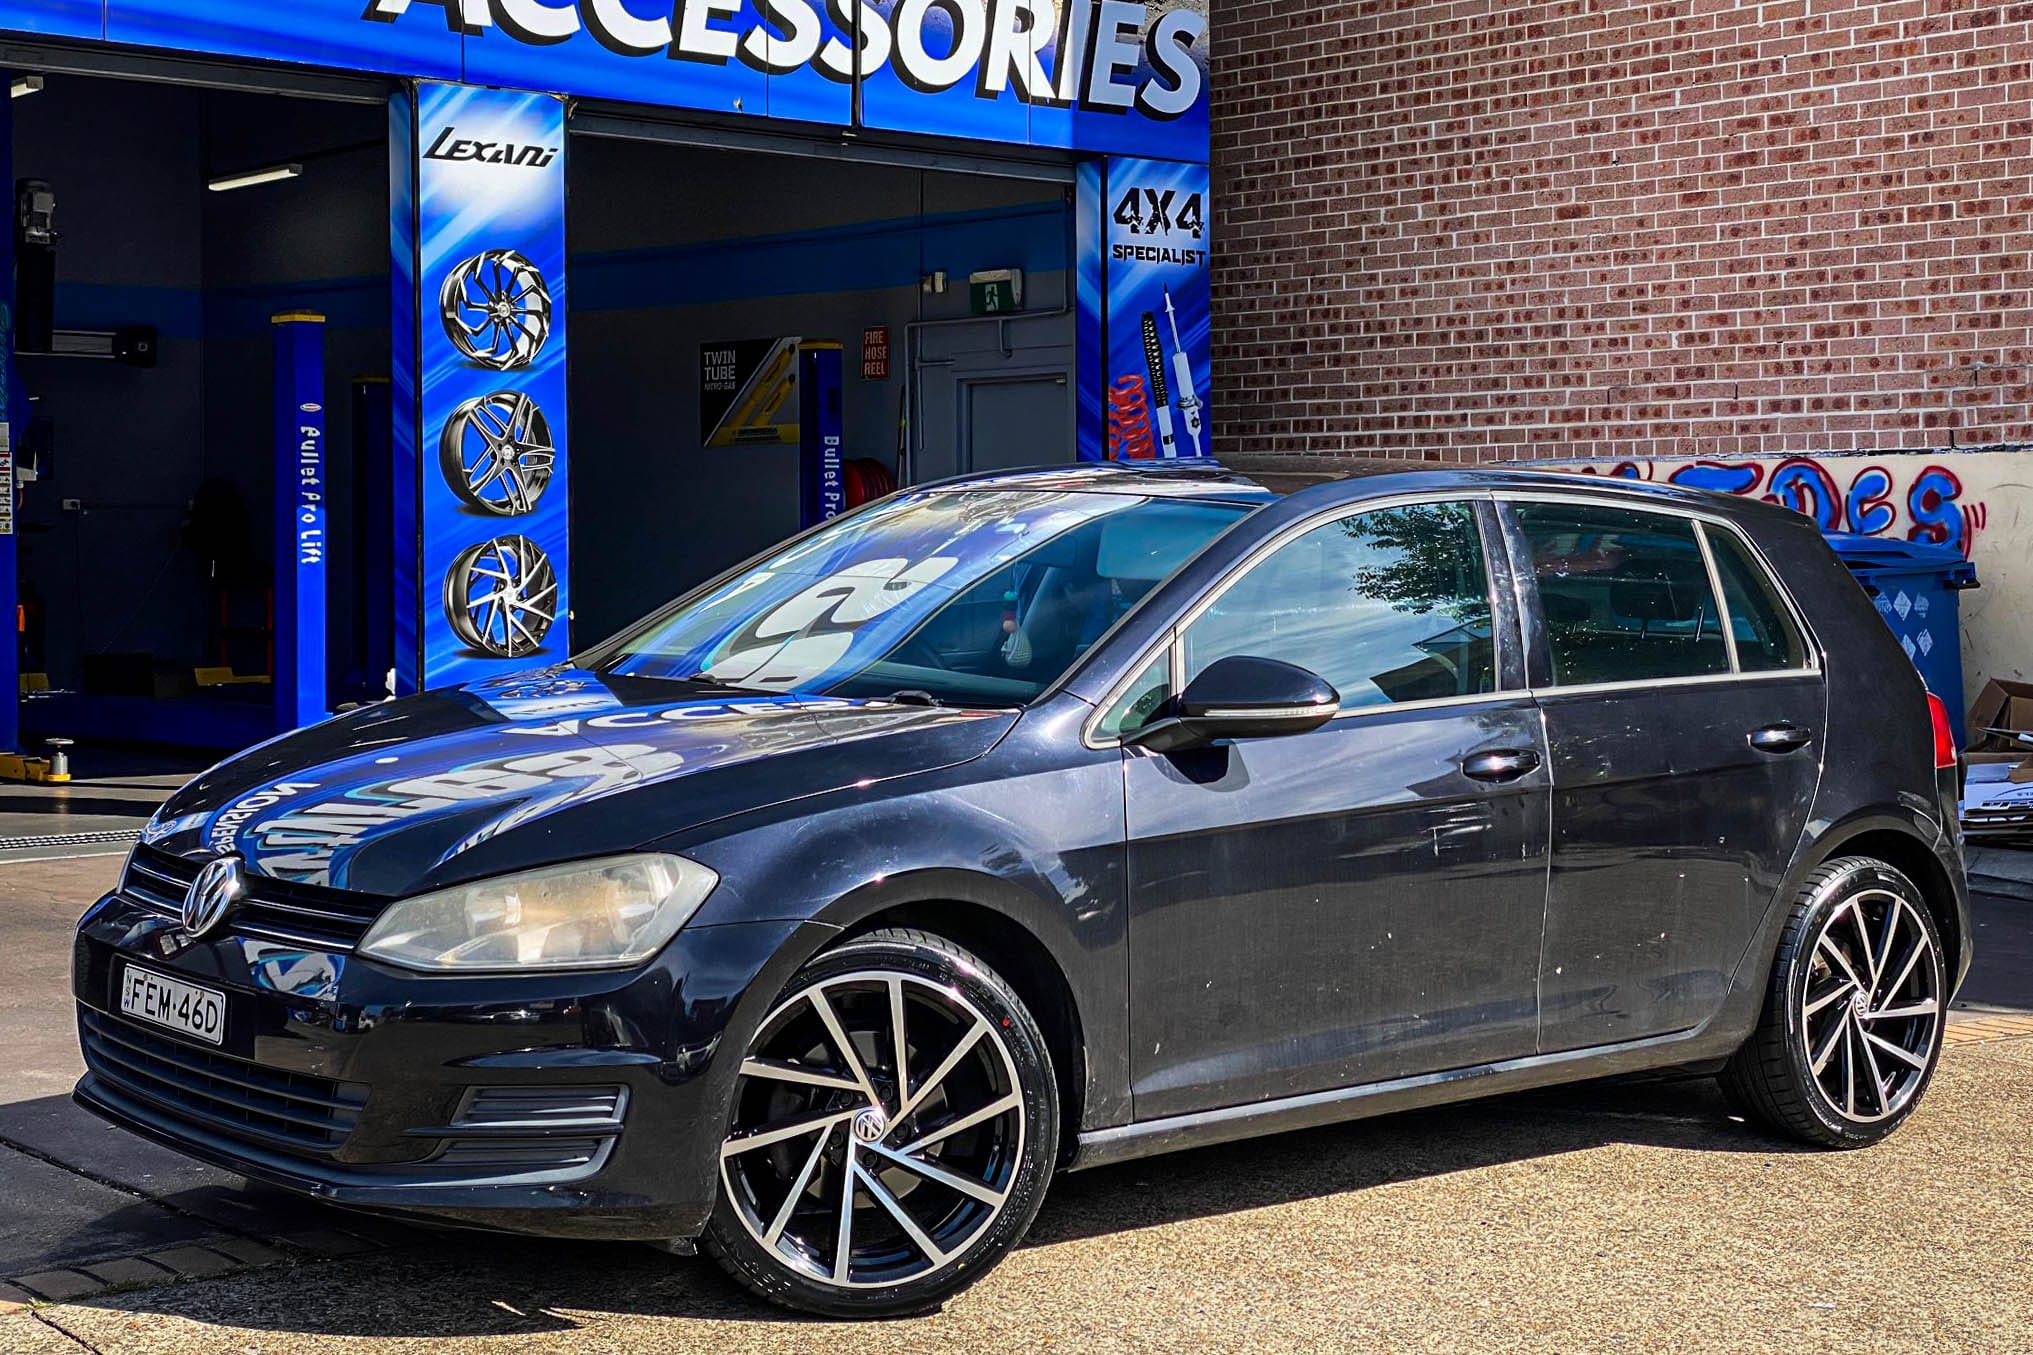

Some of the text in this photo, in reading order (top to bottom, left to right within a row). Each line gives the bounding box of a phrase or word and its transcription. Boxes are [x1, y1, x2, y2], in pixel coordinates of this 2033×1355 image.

[365, 0, 1207, 119] ESSORIES
[1113, 187, 1205, 239] 4X4
[1112, 244, 1206, 267] SPECIALIST
[864, 330, 885, 345] FIRE
[703, 349, 736, 366] TWIN
[864, 345, 888, 361] HOSE
[703, 365, 736, 381] TUBE
[864, 360, 886, 376] REEL
[300, 426, 321, 485] Bullet
[823, 435, 840, 521] Bullet Pro
[301, 491, 321, 523] Pro
[300, 530, 322, 564] Lift
